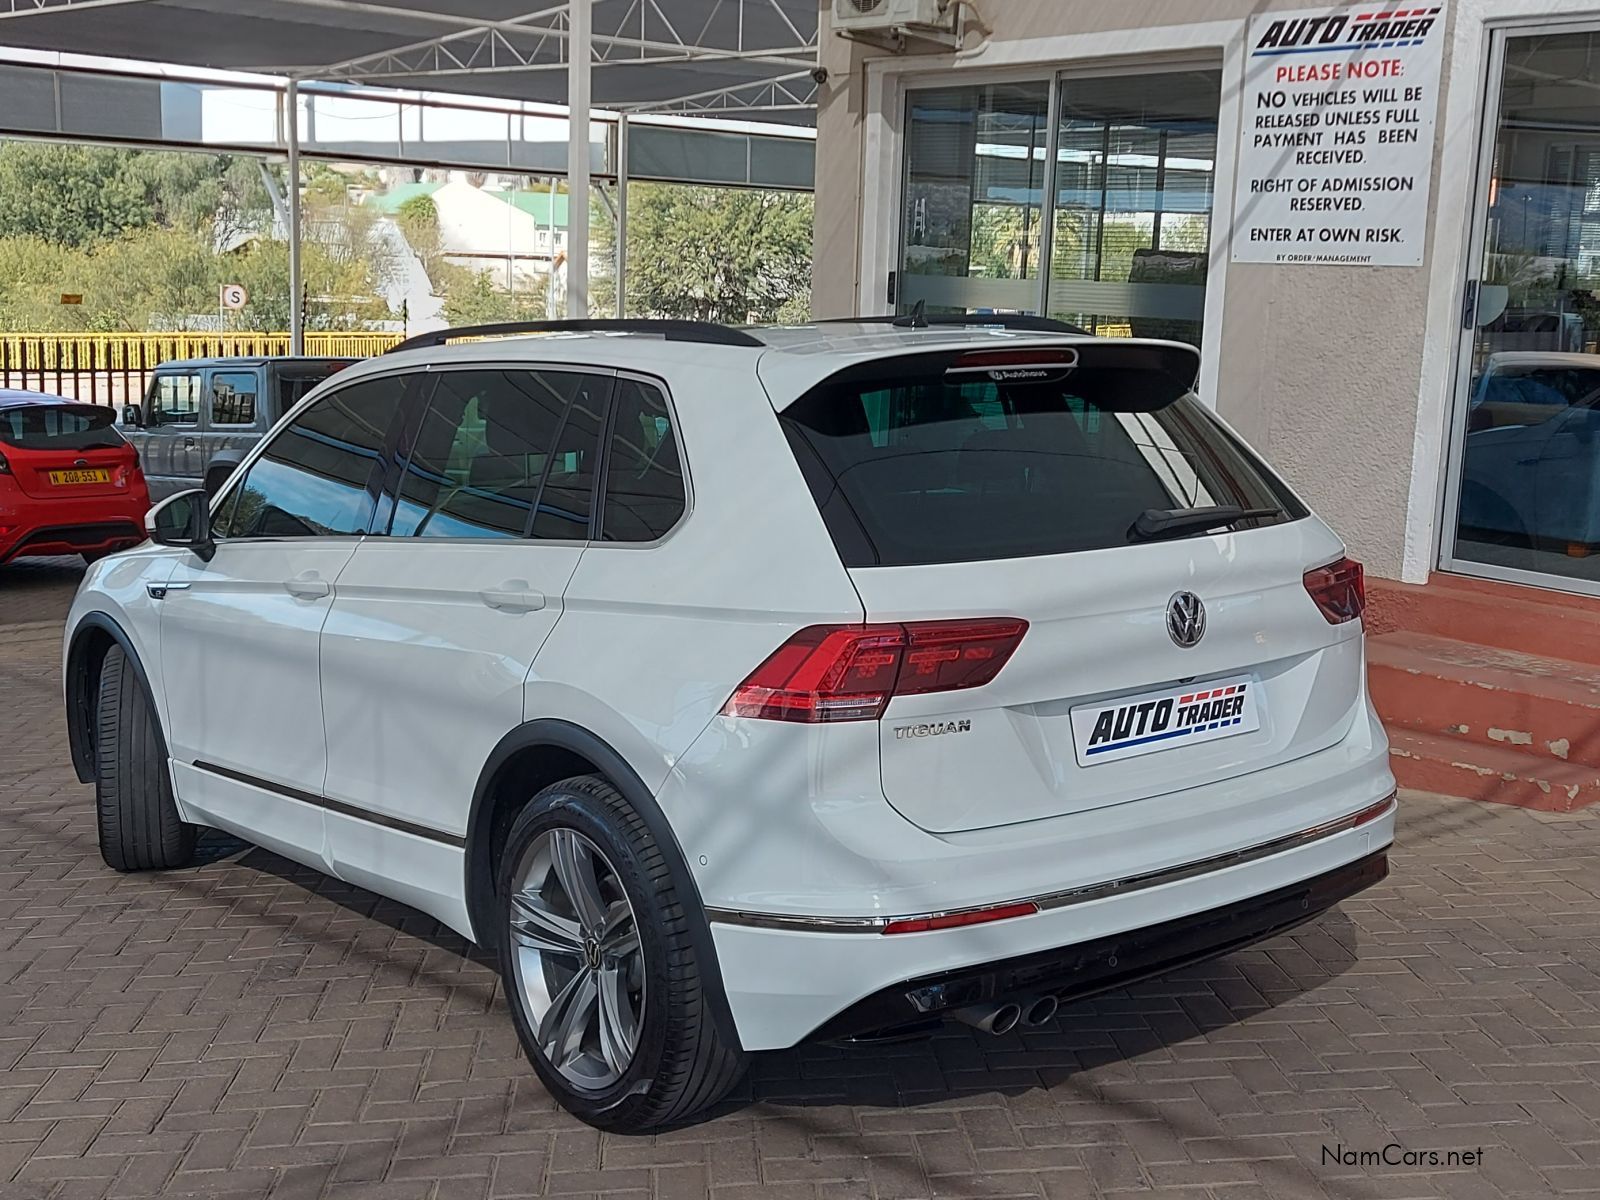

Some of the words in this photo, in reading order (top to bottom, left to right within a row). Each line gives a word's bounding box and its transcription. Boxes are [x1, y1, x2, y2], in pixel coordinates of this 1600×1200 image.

[1256, 15, 1350, 49] AUTO
[1347, 18, 1435, 43] TRADER
[1276, 63, 1341, 83] PLEASE
[1347, 59, 1405, 79] NOTE:
[1257, 91, 1287, 109] NO
[1292, 90, 1356, 107] VEHICLES
[1362, 88, 1398, 103] WILL
[1404, 87, 1423, 101] BE
[1255, 113, 1320, 129] RELEASED
[1325, 110, 1380, 126] UNLESS
[1385, 108, 1420, 124] FULL
[1254, 132, 1323, 148] PAYMENT
[1334, 130, 1366, 145] HAS
[1378, 128, 1418, 144] BEEN
[1295, 150, 1367, 165] RECEIVED.
[1251, 178, 1293, 193] RIGHT
[1297, 178, 1317, 193] OF
[1321, 176, 1414, 192] ADMISSION
[1290, 197, 1366, 212] RESERVED.
[1250, 228, 1292, 242] ENTER
[1295, 228, 1315, 242] AT
[1319, 228, 1361, 242] OWN
[1365, 228, 1405, 243] RISK.
[1276, 254, 1286, 262] BY
[230, 290, 241, 304] S
[51, 472, 60, 484] N
[893, 719, 971, 740] TIGUAN
[1088, 698, 1175, 746] AUTO
[1176, 695, 1245, 728] TRADER
